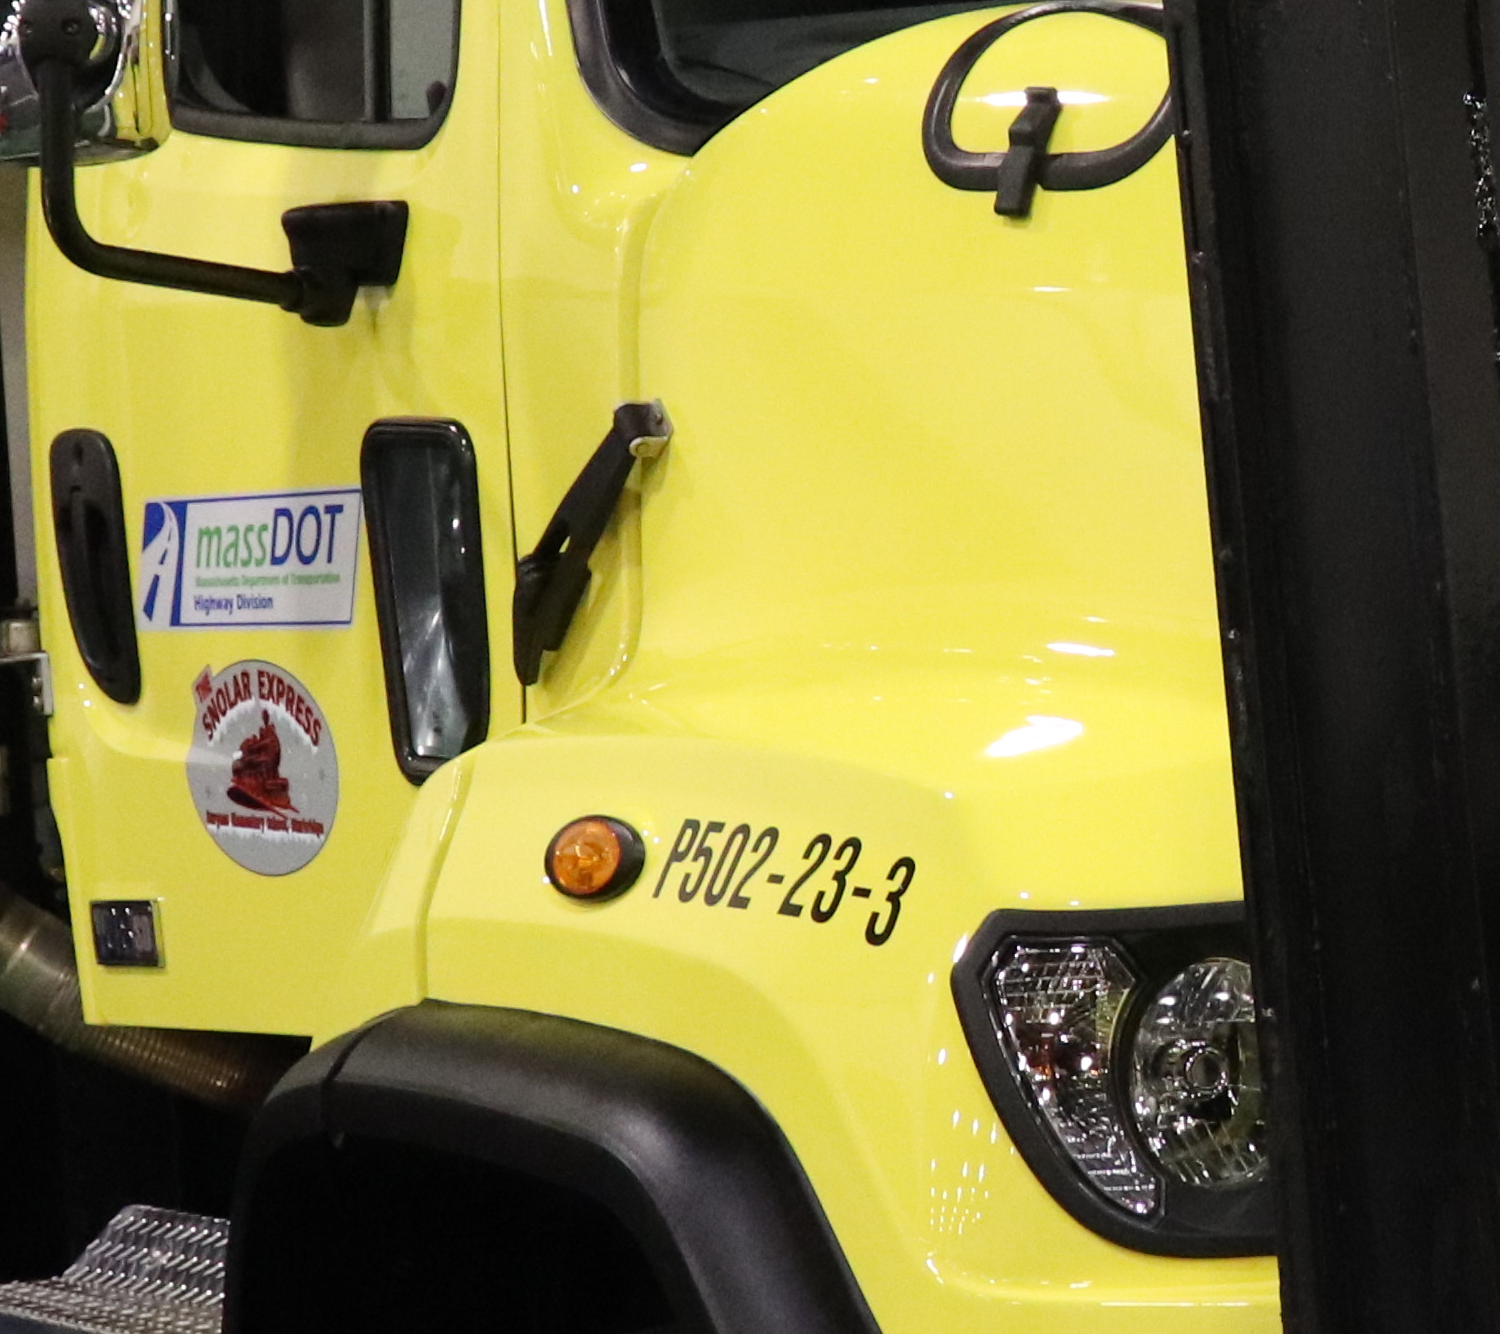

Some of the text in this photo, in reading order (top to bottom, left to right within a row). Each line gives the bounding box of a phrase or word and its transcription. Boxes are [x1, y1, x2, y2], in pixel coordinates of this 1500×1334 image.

[196, 504, 344, 568] massDOT
[194, 593, 274, 615] Highway Division
[202, 669, 322, 747] SNOLAR EXPRESS
[652, 818, 916, 947] P502-23-3
